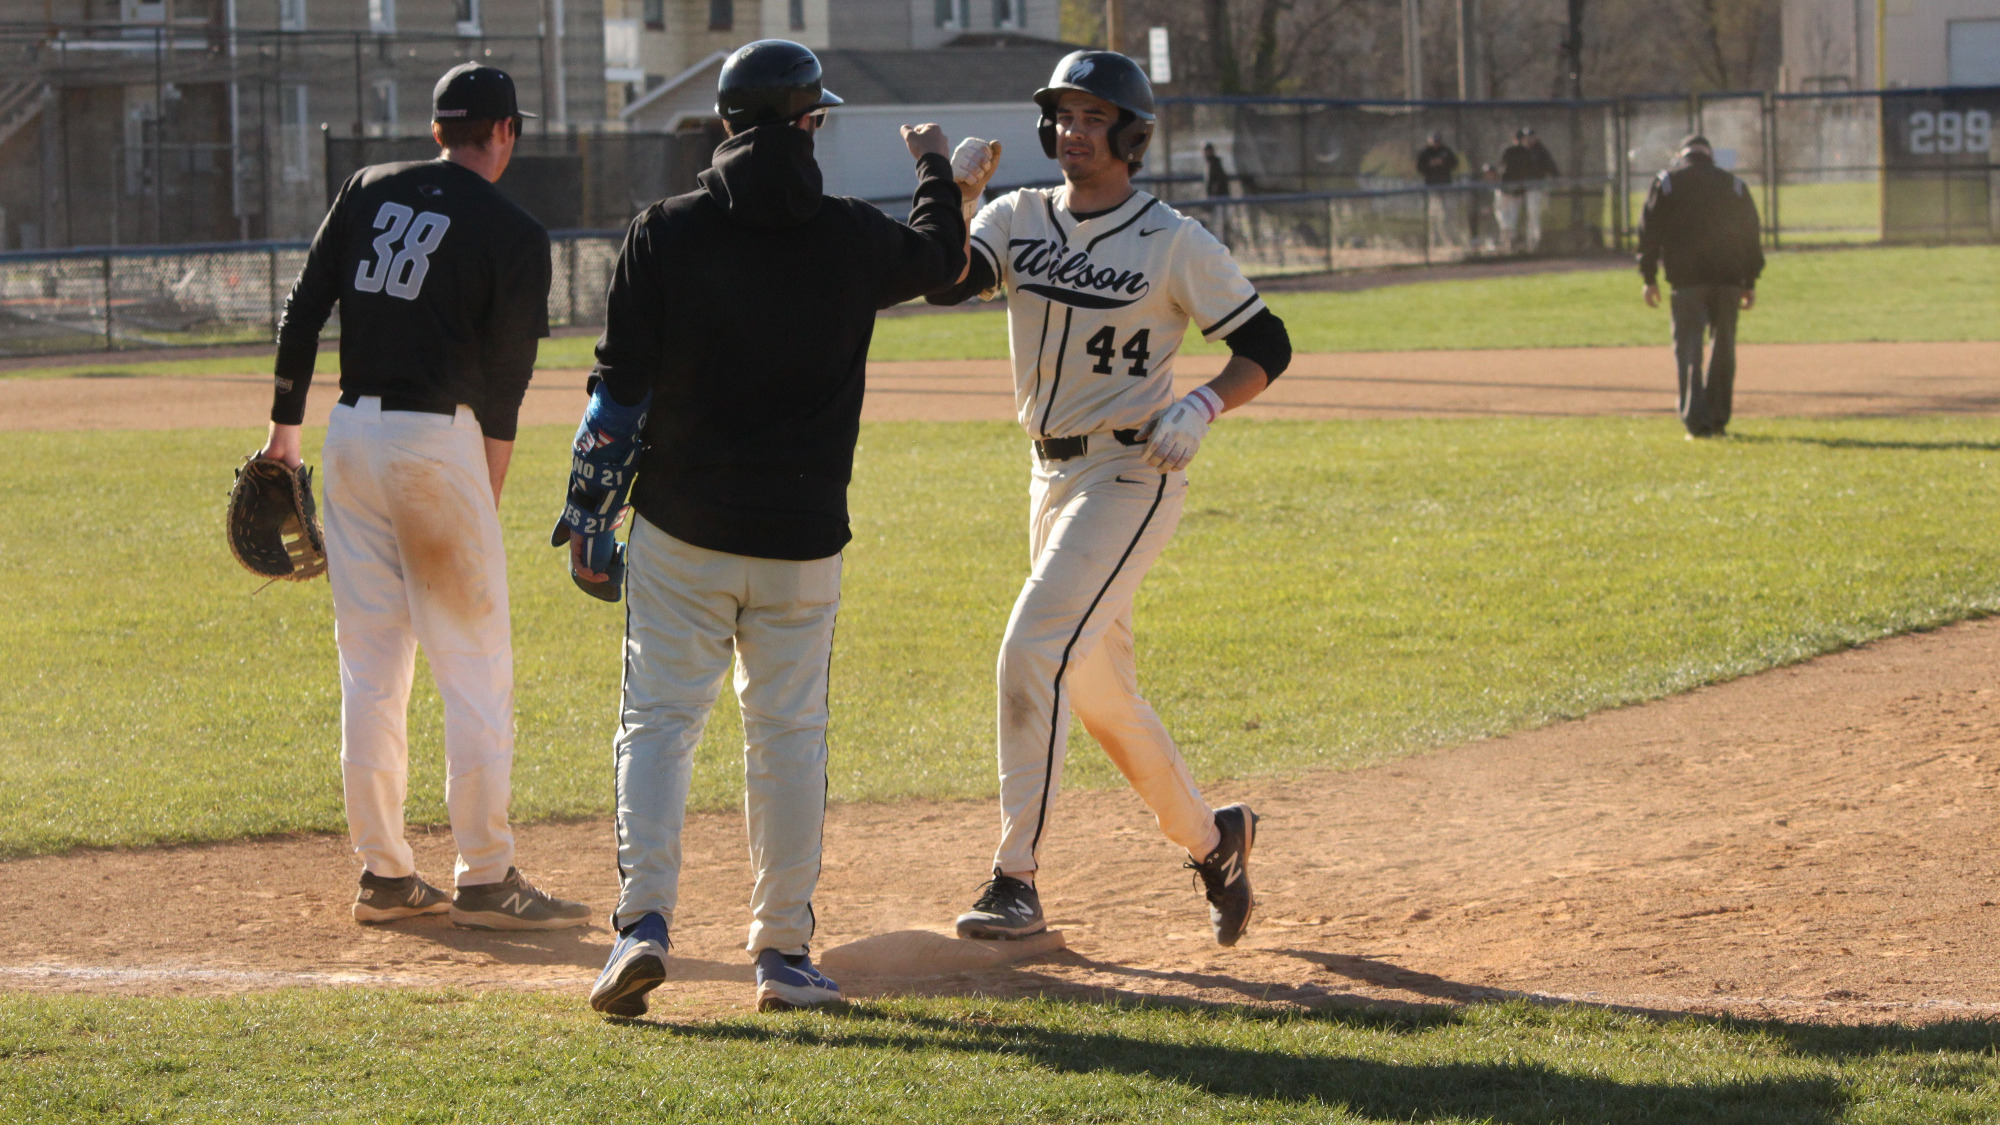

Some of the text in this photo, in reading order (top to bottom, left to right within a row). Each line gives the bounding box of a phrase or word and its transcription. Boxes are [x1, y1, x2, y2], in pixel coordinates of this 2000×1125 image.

[1908, 109, 1992, 154] 299
[354, 201, 451, 301] 38
[1008, 238, 1150, 298] Wilson
[1086, 325, 1150, 378] 44
[600, 469, 623, 487] 21
[584, 517, 607, 534] 21
